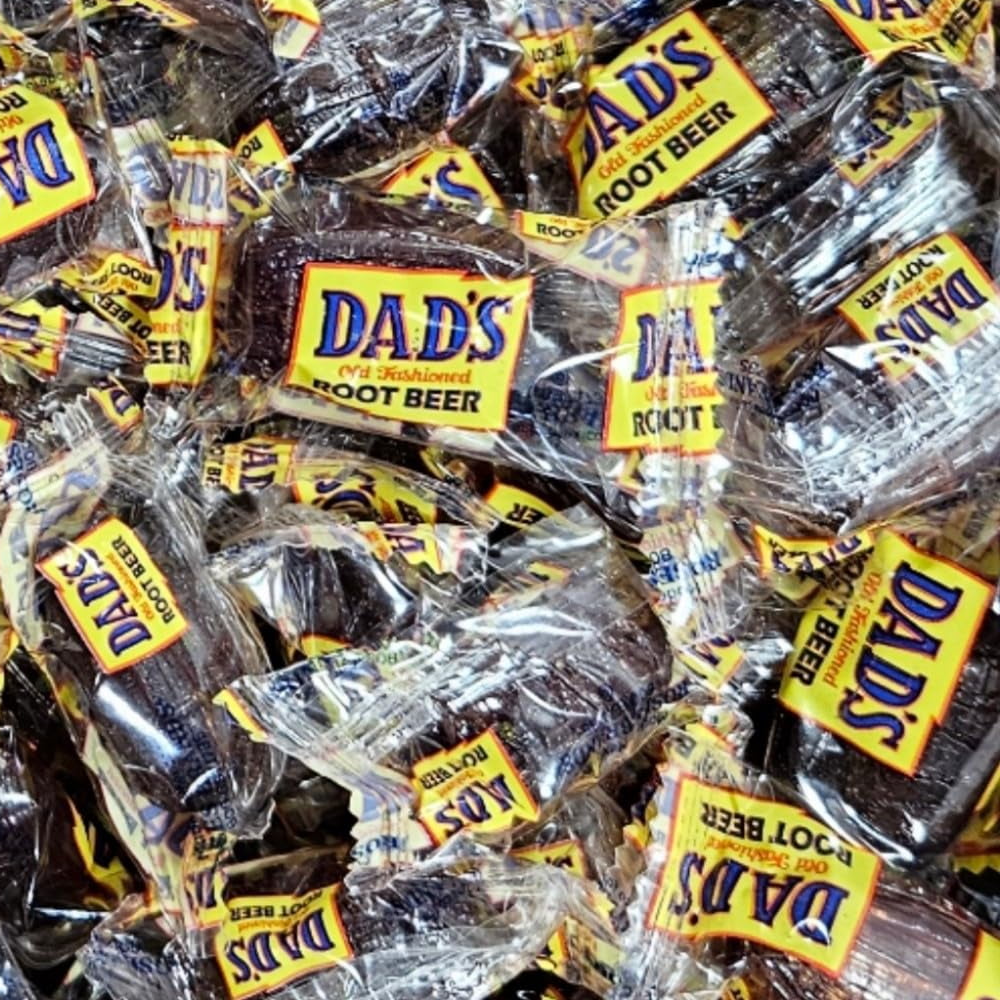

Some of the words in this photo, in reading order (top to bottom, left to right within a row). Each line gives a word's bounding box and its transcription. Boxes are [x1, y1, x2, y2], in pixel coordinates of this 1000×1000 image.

[595, 152, 670, 218] ROOT
[669, 100, 737, 161] BEER
[598, 150, 627, 179] Old
[628, 95, 706, 157] Fashioned
[109, 257, 153, 284] ROOT
[314, 290, 512, 363] DAD'S
[312, 379, 399, 405] ROOT
[403, 386, 482, 415] BEER
[338, 365, 370, 381] Old
[376, 365, 473, 386] Fashioned
[632, 405, 704, 438] ROOT
[111, 535, 145, 577] BEER
[61, 548, 153, 657] DAD'S
[139, 573, 175, 626] ROOT
[801, 618, 842, 688] BEER
[822, 606, 869, 688] Fashioned
[840, 559, 964, 751] DAD'S
[700, 802, 766, 841] BEER
[773, 820, 854, 868] ROOT
[230, 905, 277, 922] BEER
[672, 851, 850, 946] DAD'S
[223, 907, 337, 985] DAD'S
